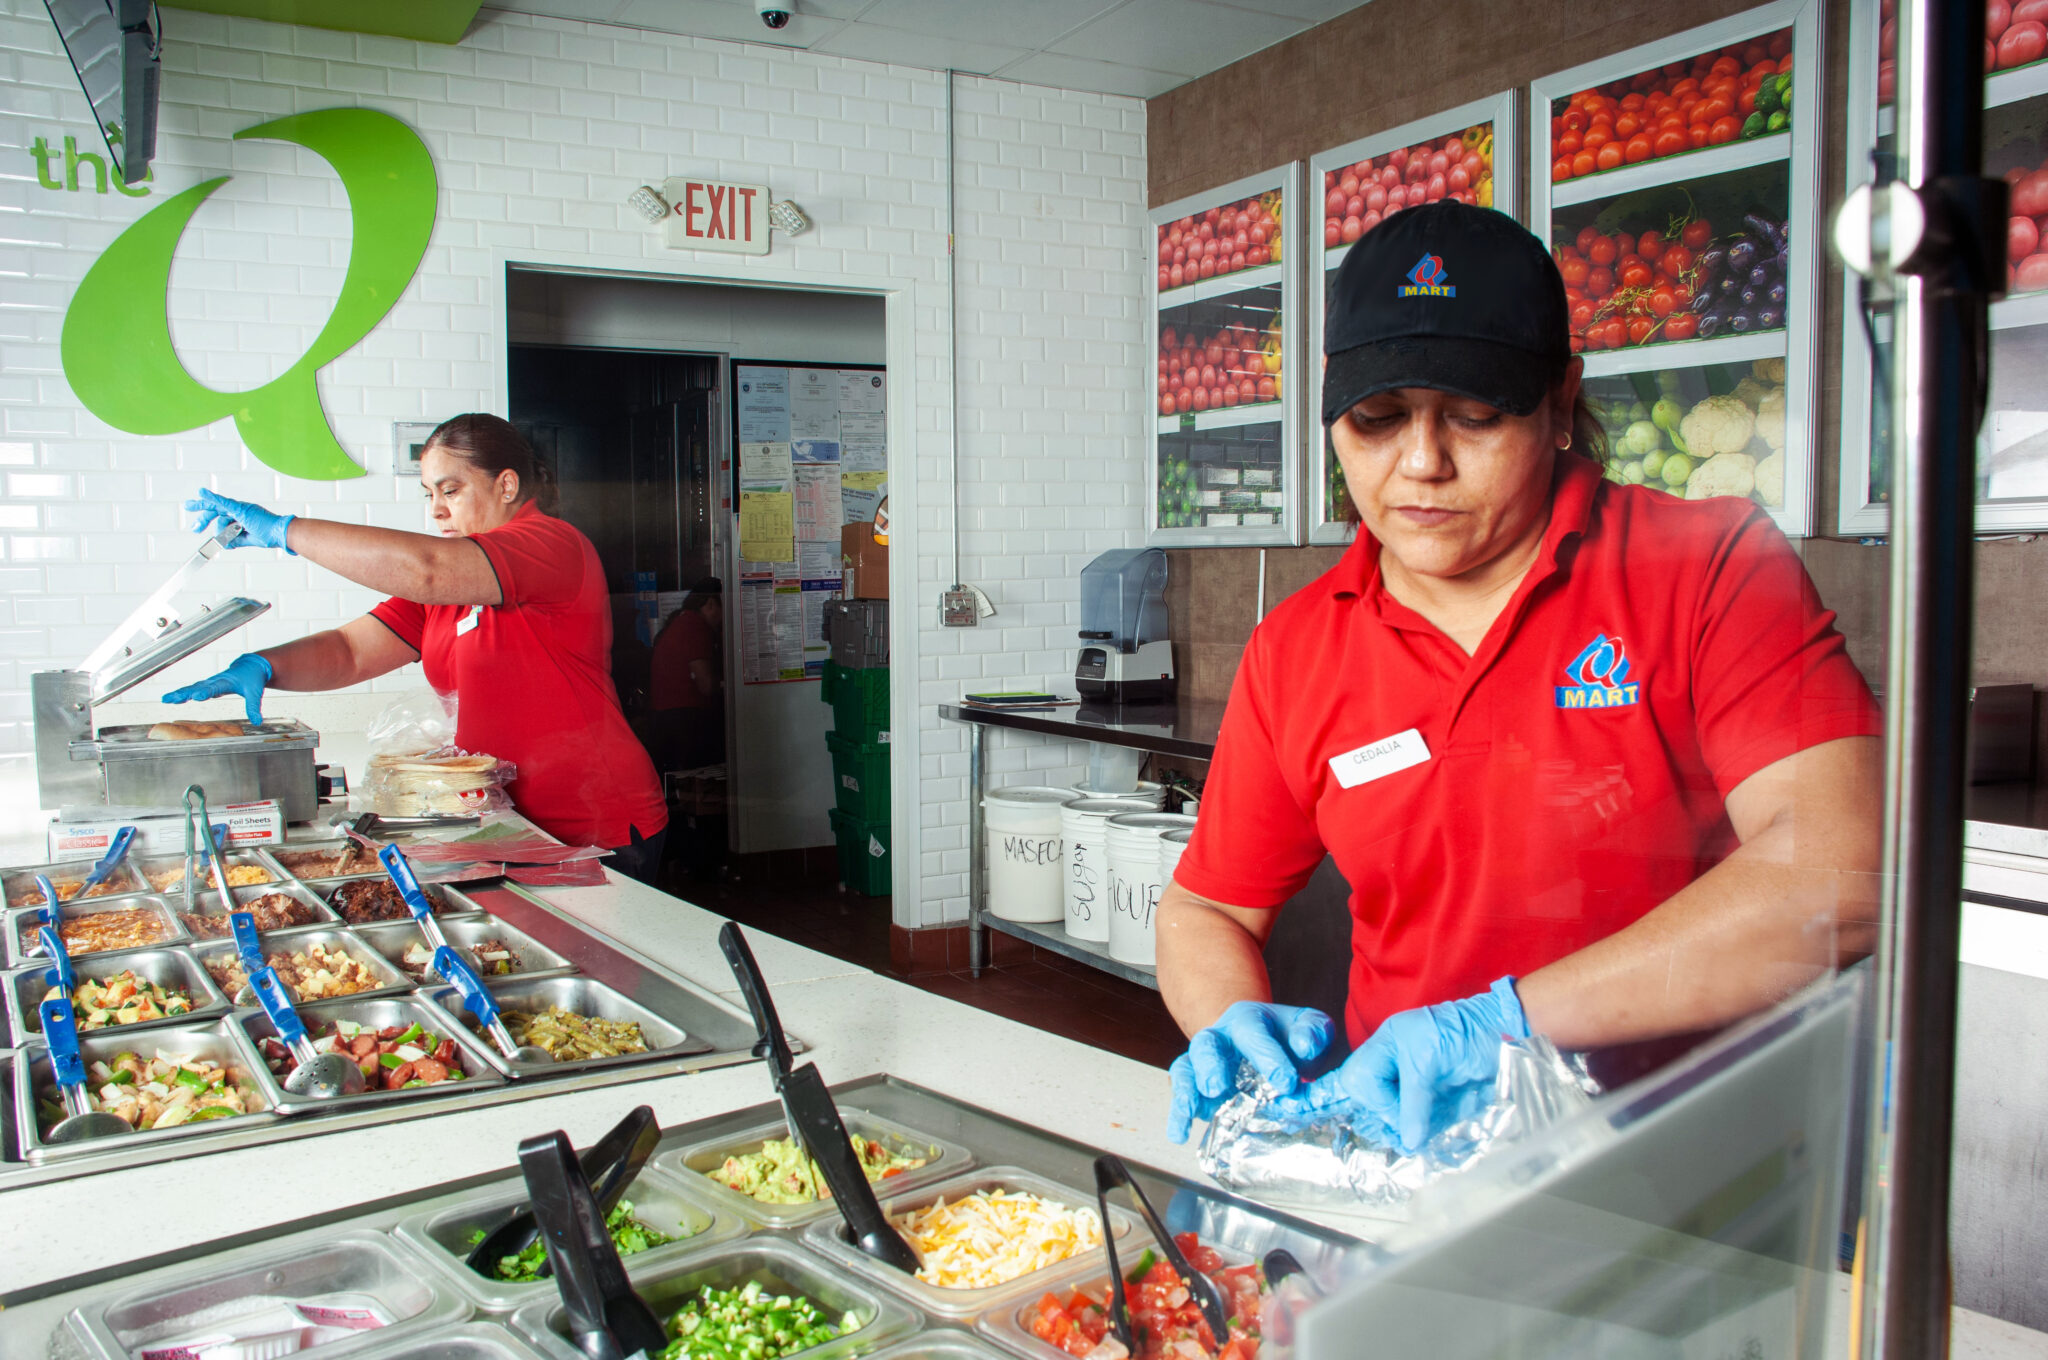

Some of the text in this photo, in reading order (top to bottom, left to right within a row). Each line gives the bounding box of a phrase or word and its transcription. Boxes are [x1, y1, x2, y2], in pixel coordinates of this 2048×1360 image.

[686, 182, 757, 242] EXIT
[1415, 255, 1443, 287] Q
[61, 108, 438, 481] Q
[1404, 286, 1451, 297] MART
[1580, 636, 1625, 690] Q
[1564, 685, 1639, 708] MART
[1353, 740, 1402, 765] CEDALIA
[69, 827, 96, 837] Sysco
